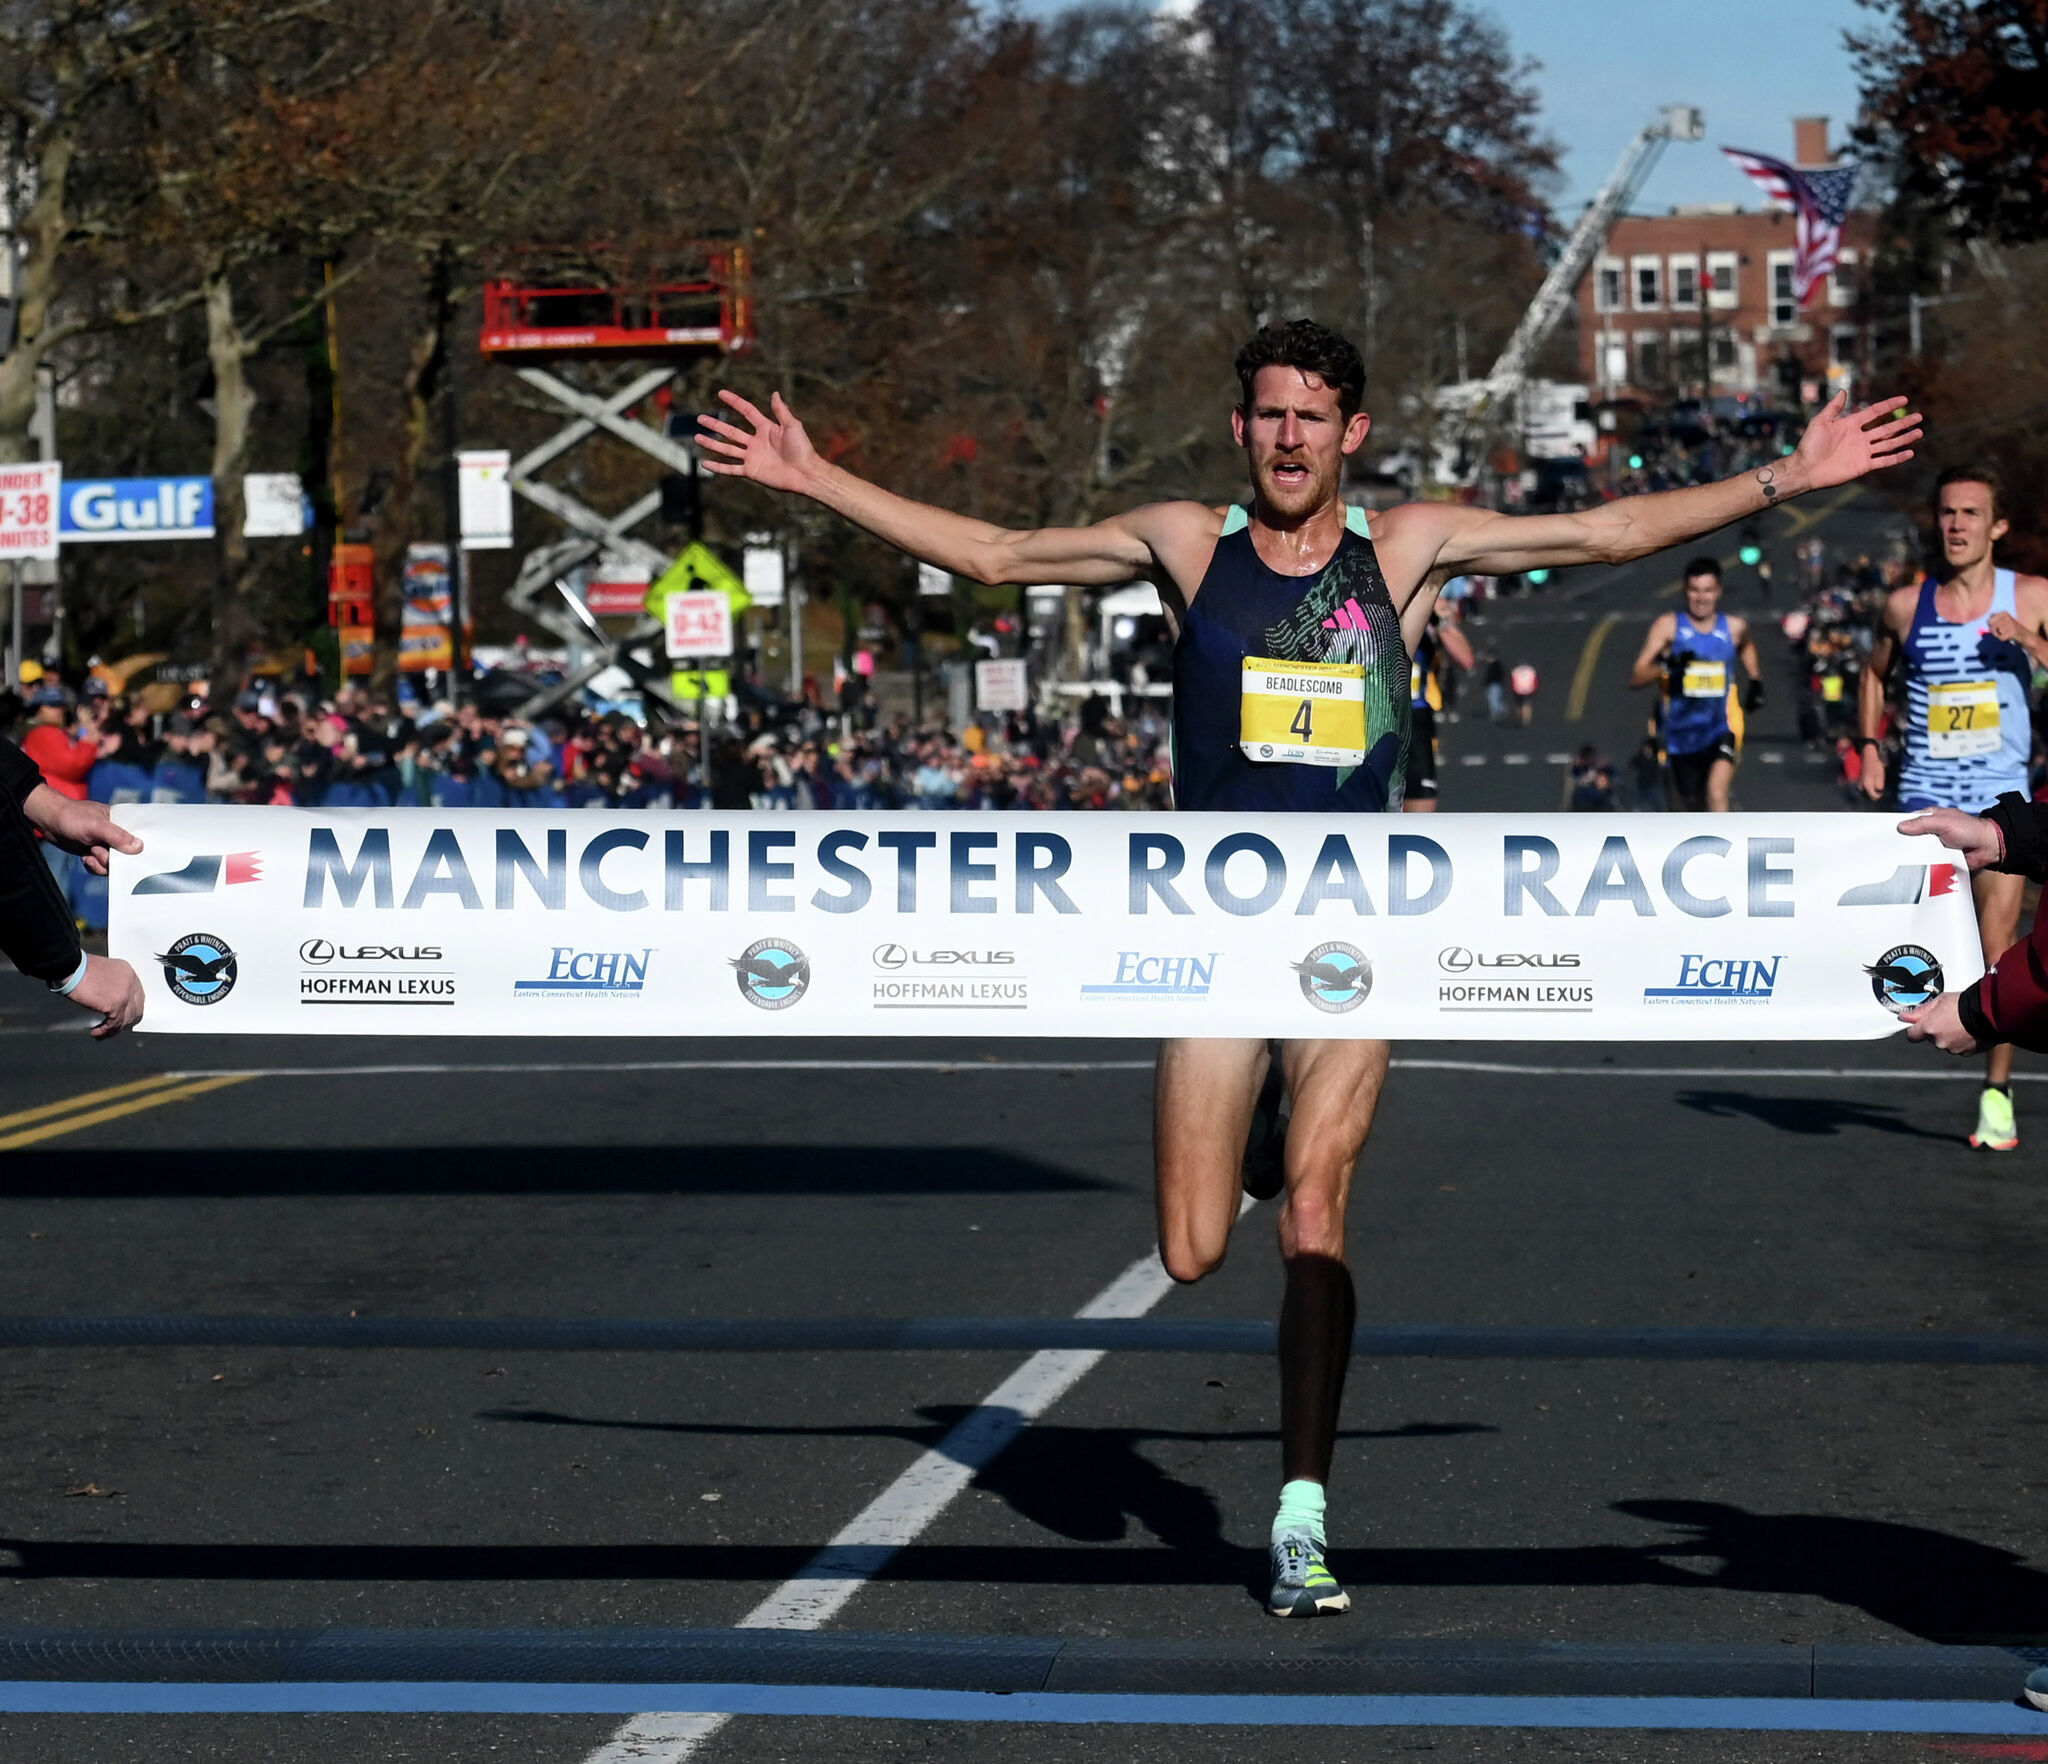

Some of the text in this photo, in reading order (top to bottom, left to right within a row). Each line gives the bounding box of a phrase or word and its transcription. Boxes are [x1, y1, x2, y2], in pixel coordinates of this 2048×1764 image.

[0, 470, 42, 490] NDER
[69, 481, 204, 530] Gulf
[1266, 676, 1343, 695] BEADLESCOMB
[1290, 699, 1313, 743] 4
[1948, 705, 1975, 731] 27
[303, 827, 1795, 919] MANCHESTER ROAD RACE
[174, 935, 227, 953] PRATT & WHITNEY
[339, 946, 443, 960] LEXUS
[912, 950, 1015, 965] LEXUS
[1478, 953, 1581, 968] LEXUS
[1882, 947, 1902, 964] PRATT
[1909, 947, 1933, 963] WHITNEY
[546, 947, 653, 988] ECHN
[1113, 951, 1218, 991] ECHN
[1676, 954, 1782, 994] ECHN
[301, 979, 455, 995] HOFFMAN LEXUS
[513, 990, 540, 998] Eastern
[541, 990, 583, 998] Connecticut
[610, 991, 641, 999] Network
[874, 983, 1028, 999] HOFFMAN LEXUS
[1440, 986, 1593, 1002] HOFFMAN LEXUS
[1643, 997, 1669, 1005] Eastern
[1738, 998, 1770, 1006] Network
